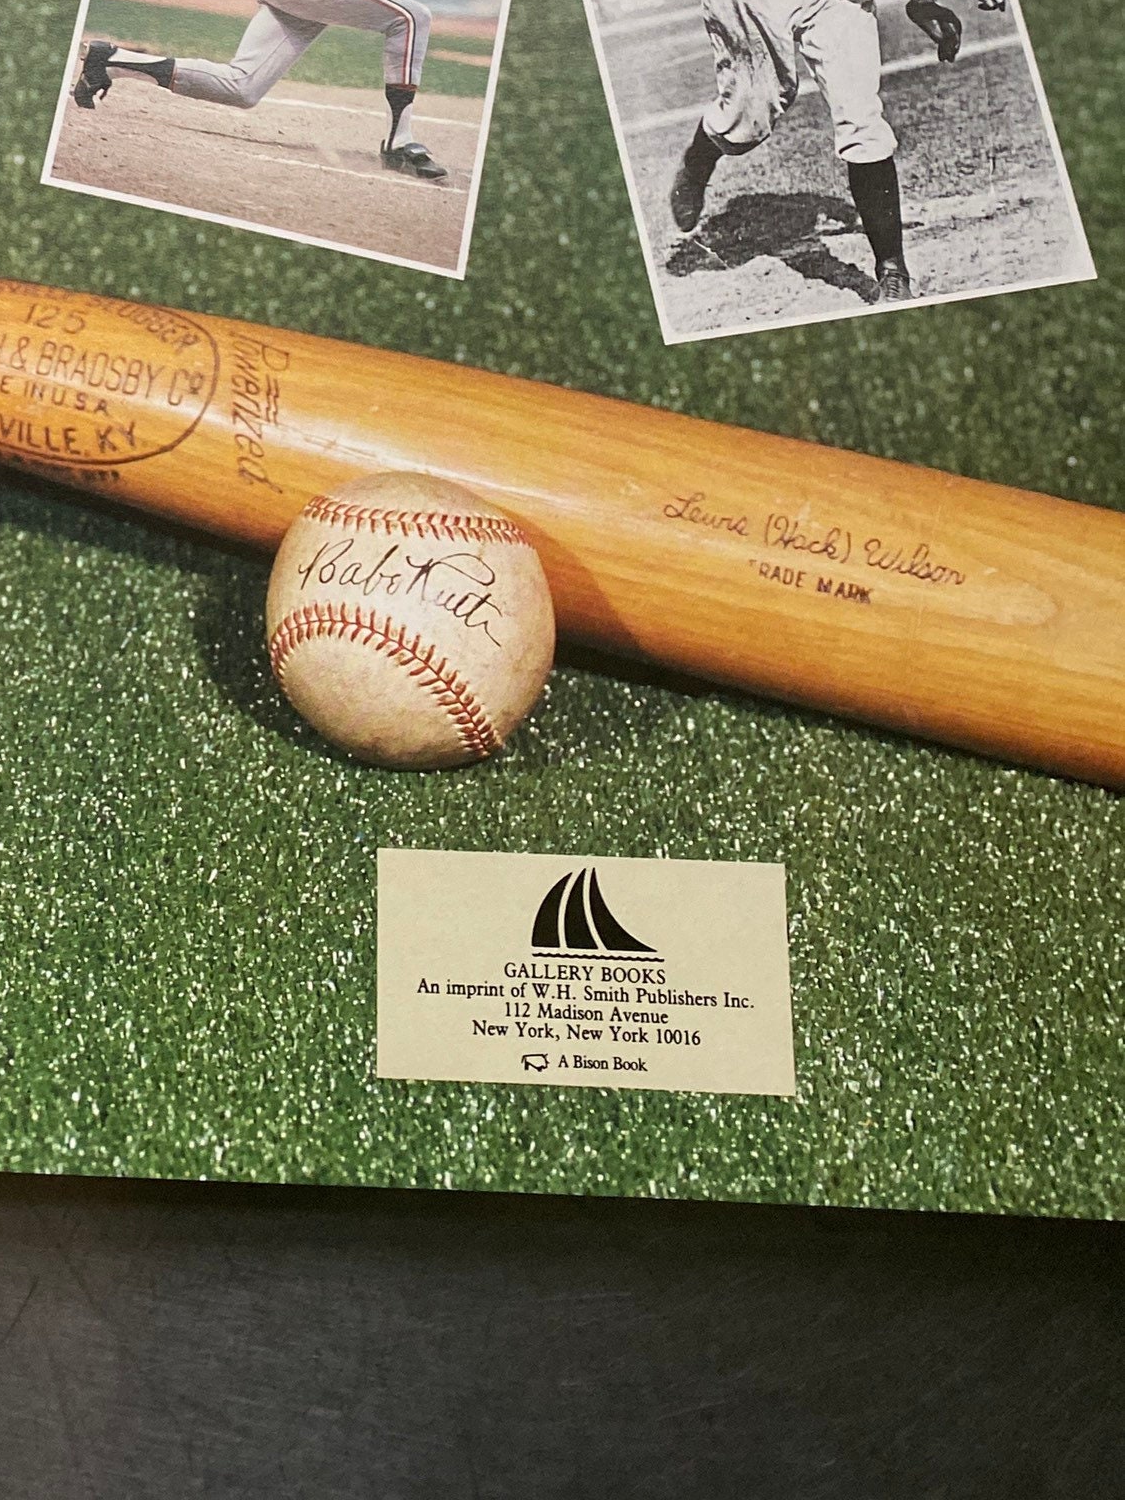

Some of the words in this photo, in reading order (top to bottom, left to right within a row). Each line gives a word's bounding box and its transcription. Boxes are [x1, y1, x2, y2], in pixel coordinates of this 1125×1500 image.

[24, 302, 86, 335] 125
[9, 336, 30, 370] &
[36, 340, 165, 399] BRADSBY
[297, 537, 401, 597] Babe
[864, 537, 967, 586] Wilson
[504, 962, 594, 982] GALLERY
[600, 966, 666, 985] BOOKS
[416, 977, 440, 995] An
[446, 981, 505, 1000] imprint
[510, 982, 528, 998] of
[531, 982, 577, 1001] W.H.
[583, 985, 630, 1003] Smith
[635, 987, 718, 1007] Publishers
[723, 991, 755, 1009] Inc.
[505, 1001, 531, 1018] 112
[537, 1002, 604, 1022] Madison
[609, 1006, 669, 1025] Avenue
[472, 1019, 509, 1037] New
[514, 1021, 561, 1042] York,
[566, 1023, 603, 1041] New
[608, 1025, 650, 1044] York
[656, 1028, 701, 1046] 10016
[557, 1054, 569, 1069] A
[572, 1054, 609, 1071] Bison
[612, 1056, 649, 1072] Book
